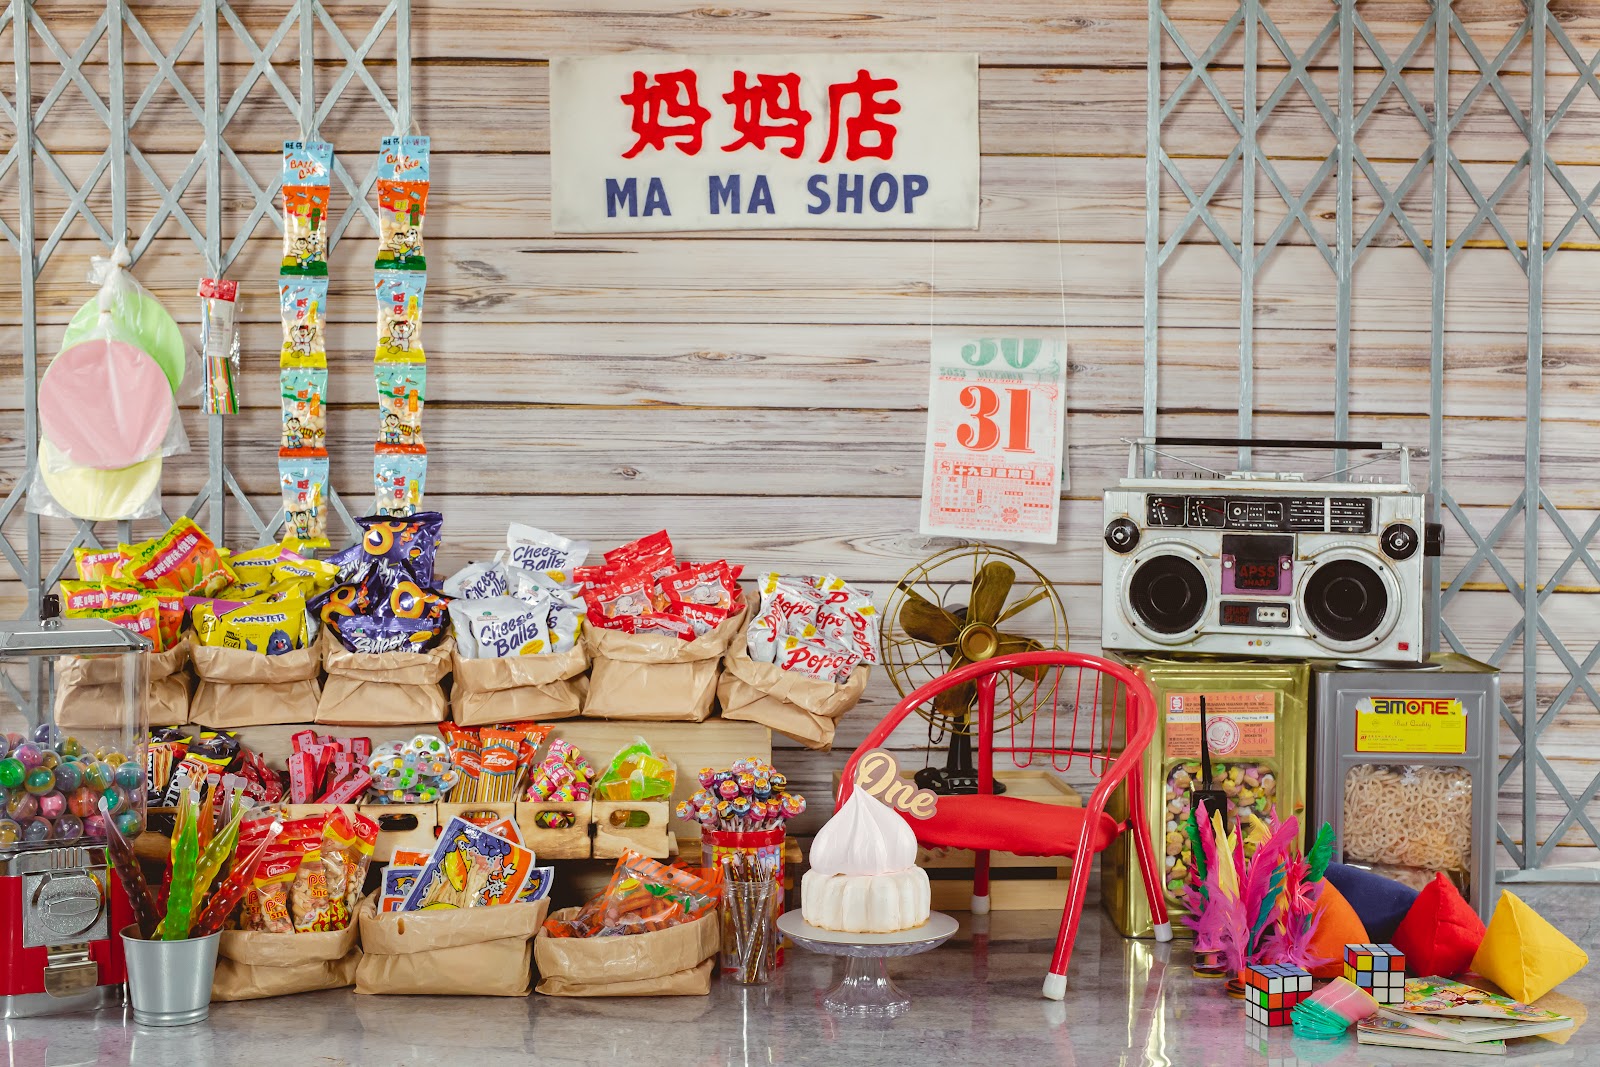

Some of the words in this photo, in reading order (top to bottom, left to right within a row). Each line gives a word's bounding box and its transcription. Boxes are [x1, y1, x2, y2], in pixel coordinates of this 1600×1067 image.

[620, 69, 901, 163] 妈妈店
[605, 177, 671, 218] MA
[708, 174, 775, 215] MA
[806, 172, 929, 215] SHOP
[956, 385, 1035, 453] 31
[1240, 565, 1276, 577] APSS
[233, 613, 286, 623] MONSTER
[493, 622, 539, 658] Balls
[781, 646, 847, 674] Popo
[484, 754, 514, 766] Tasty
[856, 752, 934, 816] One
